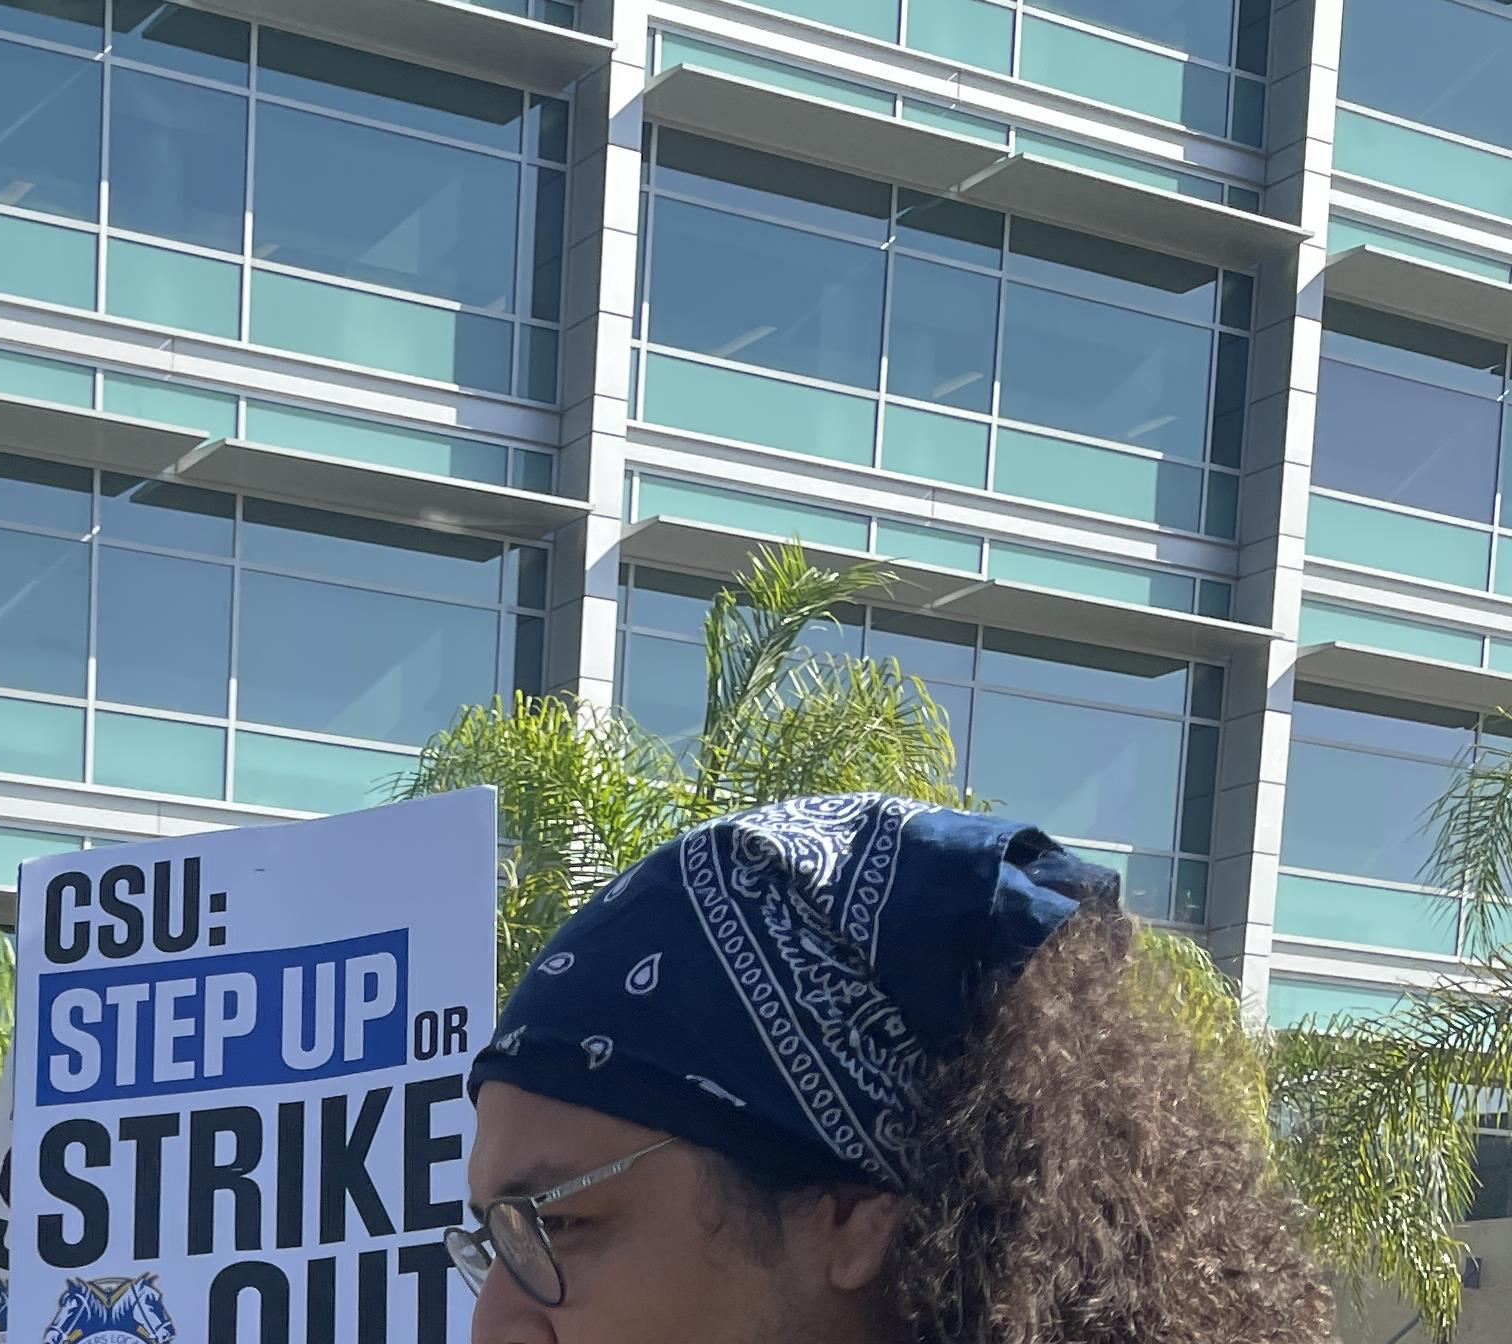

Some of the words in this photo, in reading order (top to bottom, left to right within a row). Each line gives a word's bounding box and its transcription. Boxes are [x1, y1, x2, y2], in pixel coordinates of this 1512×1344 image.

[44, 856, 228, 964] CSU:
[48, 971, 258, 1094] STEP
[280, 951, 398, 1072] UP
[413, 1006, 468, 1062] OR
[37, 1073, 465, 1269] STRIKE
